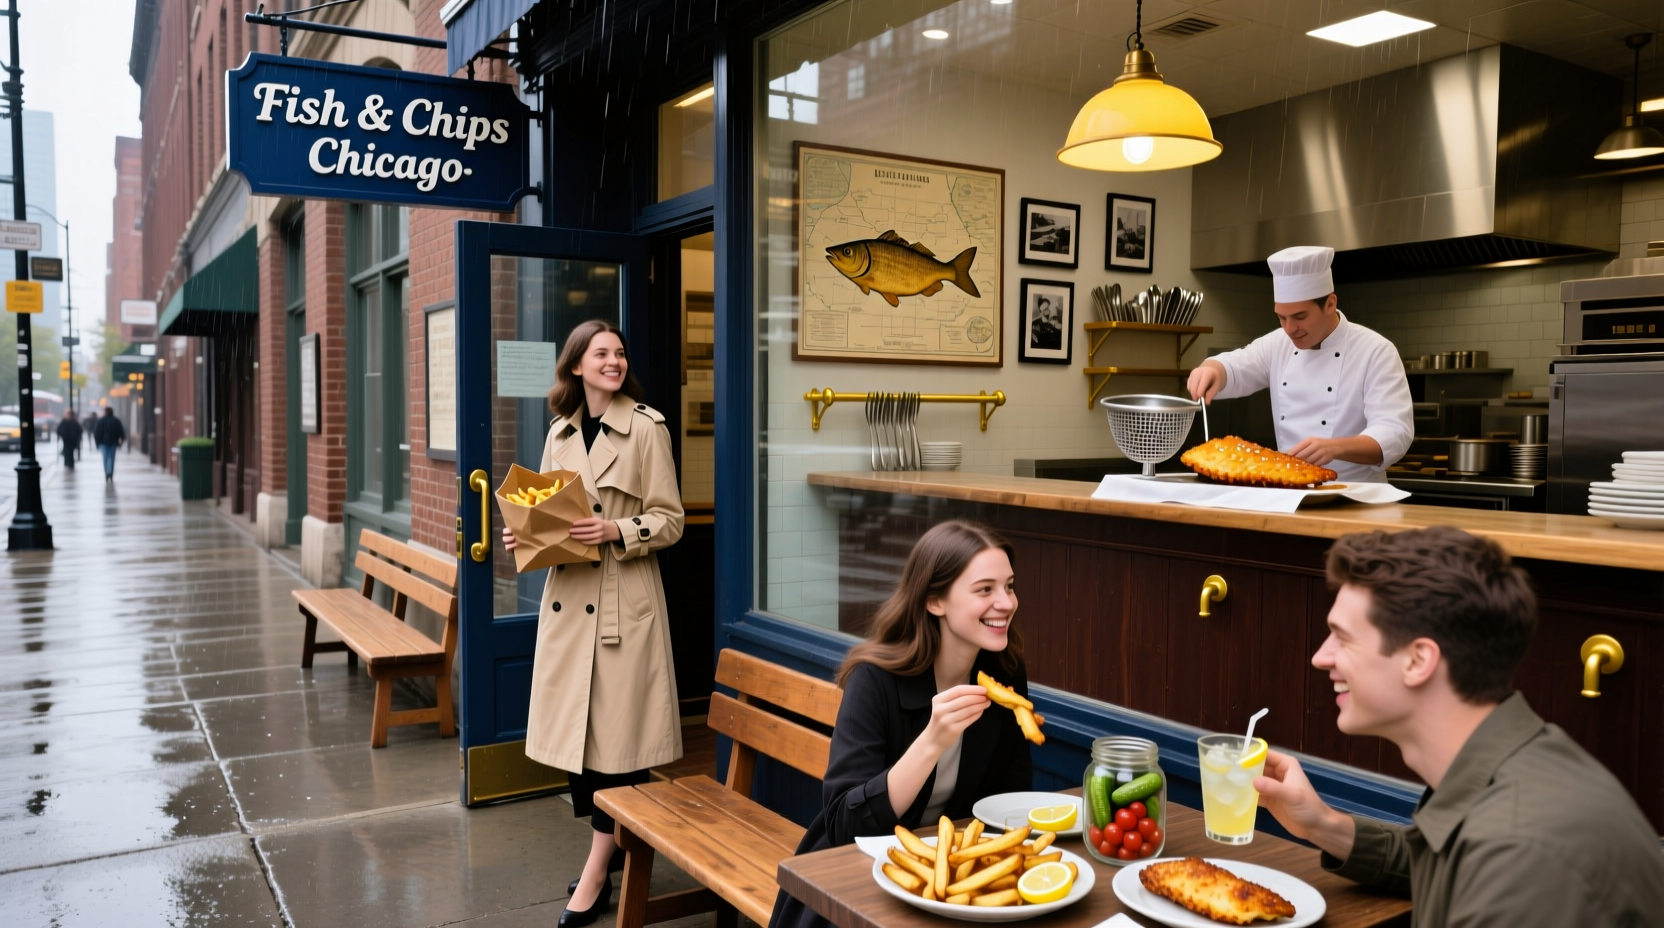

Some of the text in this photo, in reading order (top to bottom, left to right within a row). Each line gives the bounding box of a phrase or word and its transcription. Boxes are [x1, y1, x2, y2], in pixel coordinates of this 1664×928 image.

[253, 82, 510, 150] Fish & Chips
